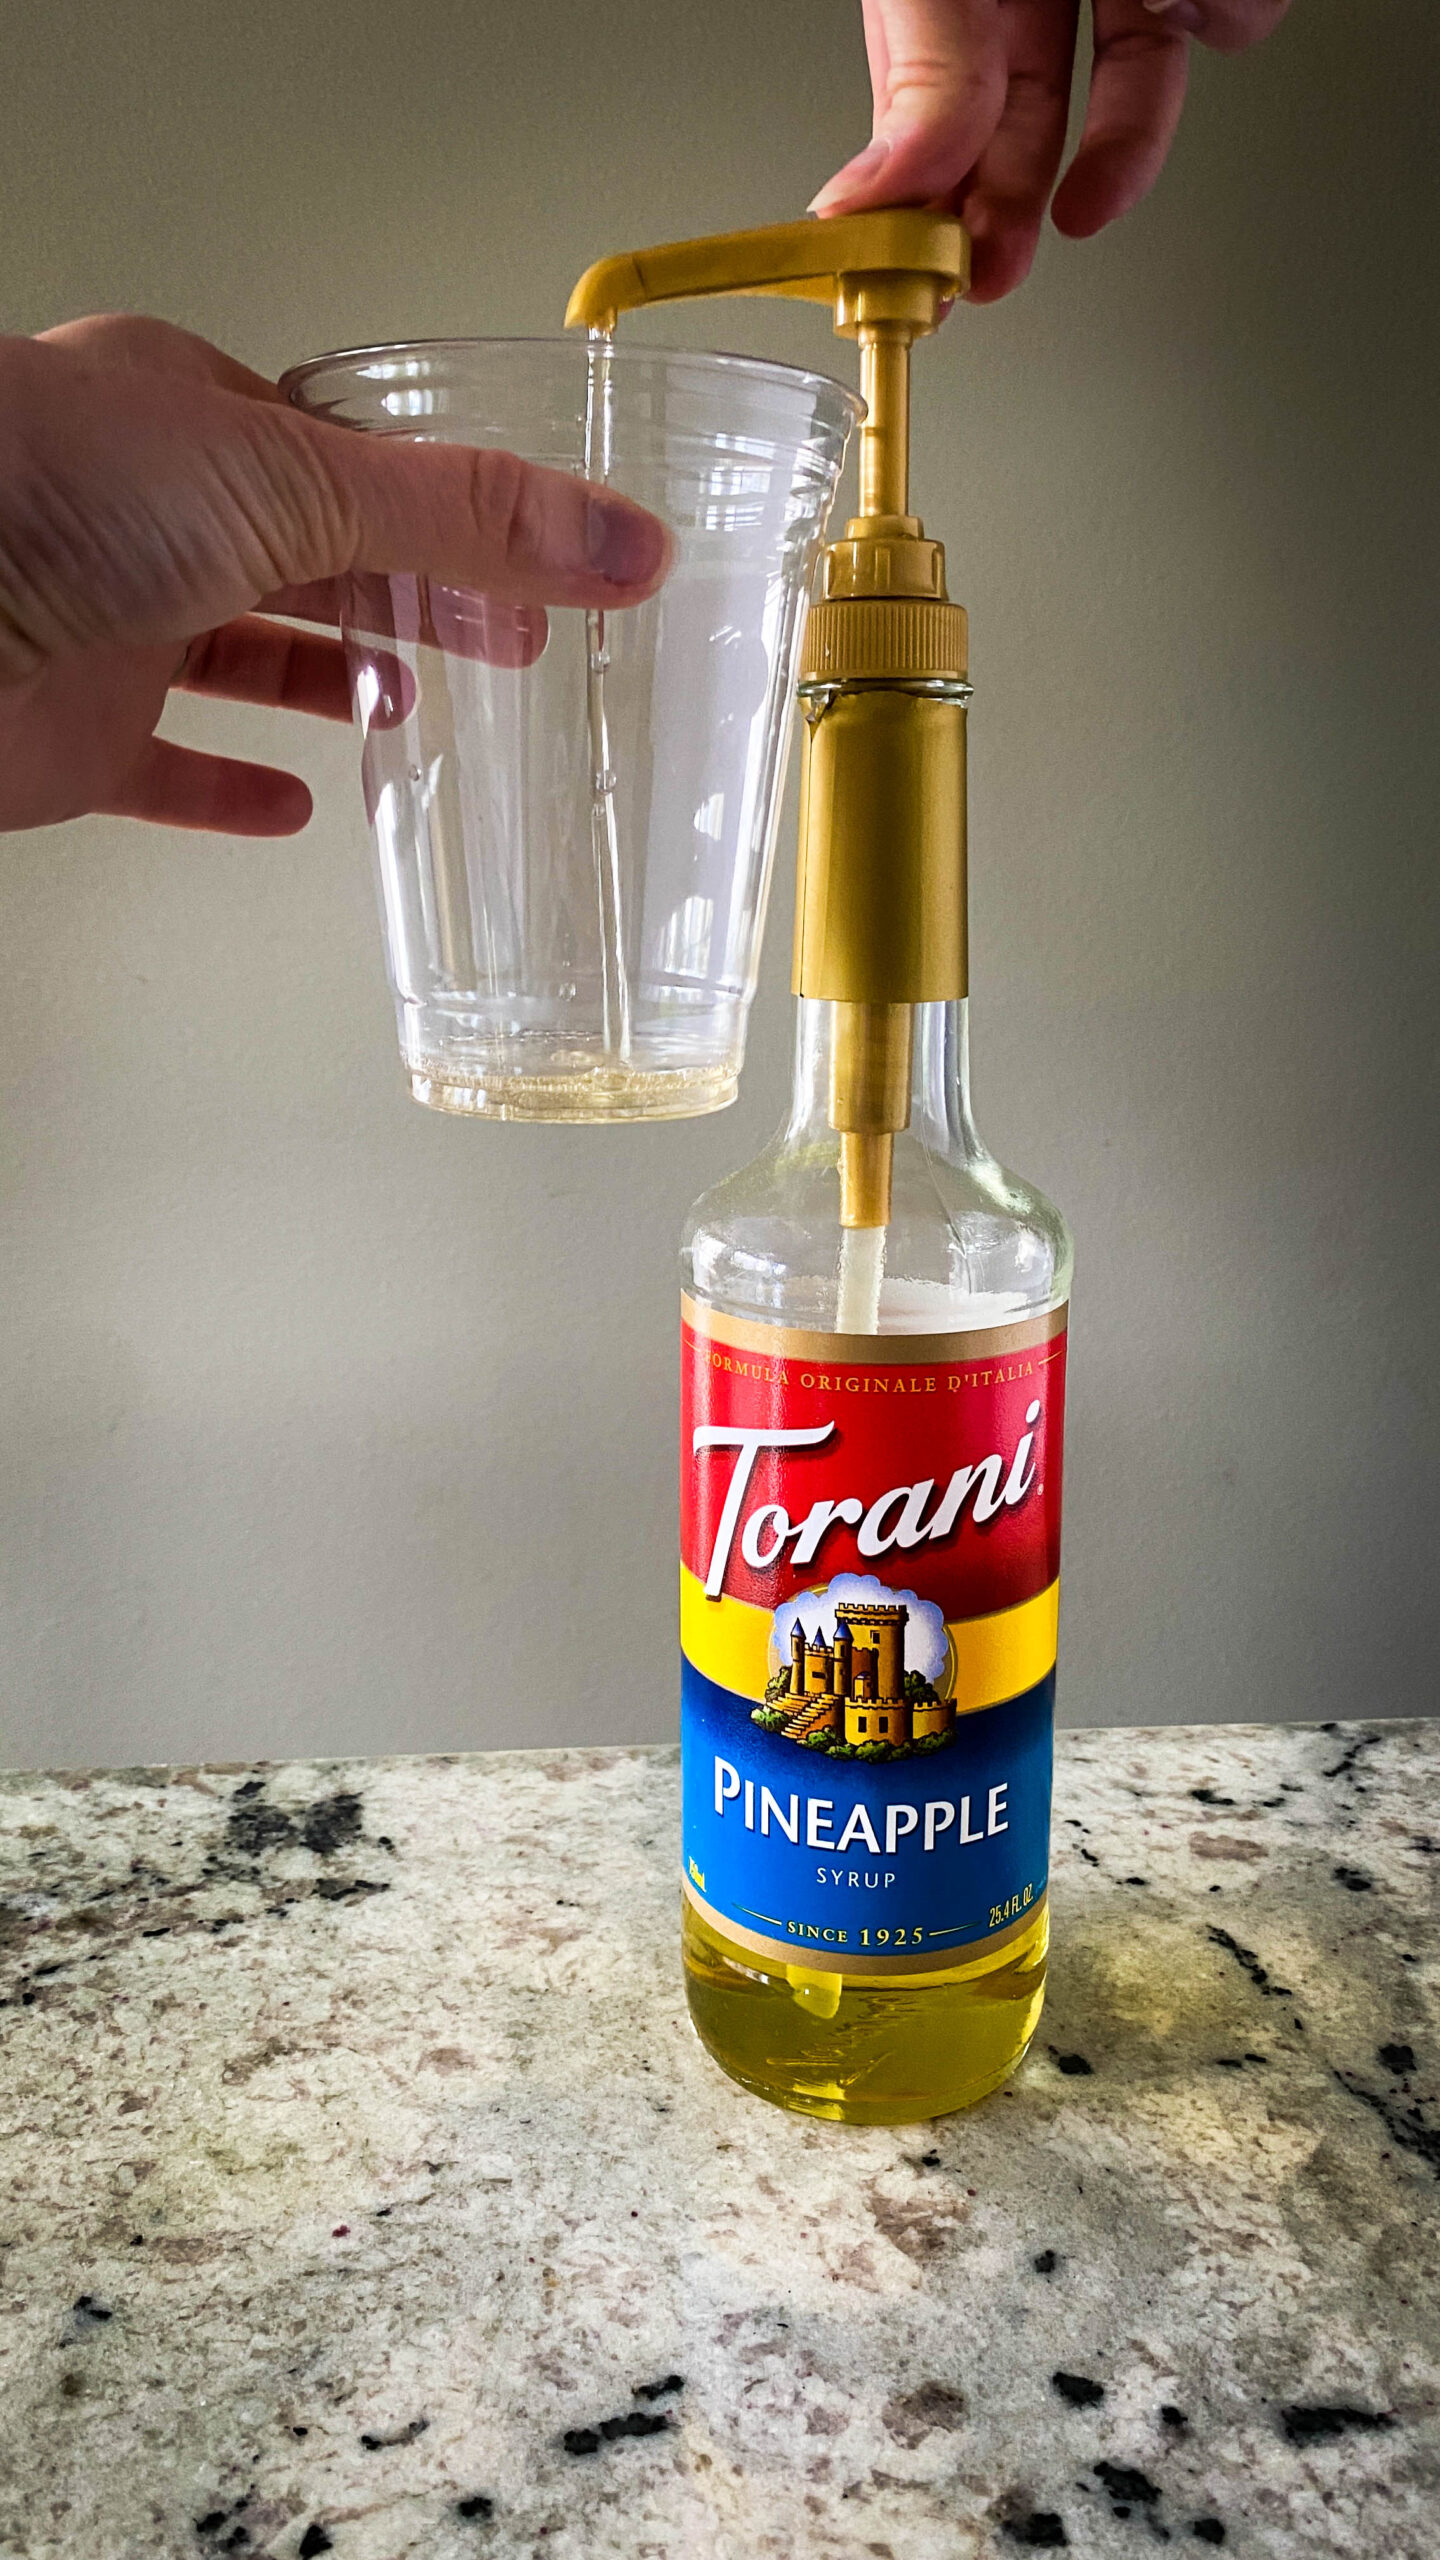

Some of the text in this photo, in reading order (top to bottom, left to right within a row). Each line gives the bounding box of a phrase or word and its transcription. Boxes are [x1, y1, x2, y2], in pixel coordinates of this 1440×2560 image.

[801, 1373, 937, 1392] ORIGINALE
[948, 1361, 1033, 1393] D'ITALIA
[693, 1399, 1041, 1597] Torani
[714, 1756, 1009, 1854] PINEAPPLE
[816, 1867, 896, 1889] SYRUP
[989, 1900, 1010, 1928] 25.4
[787, 1921, 923, 1946] SINCE 1925
